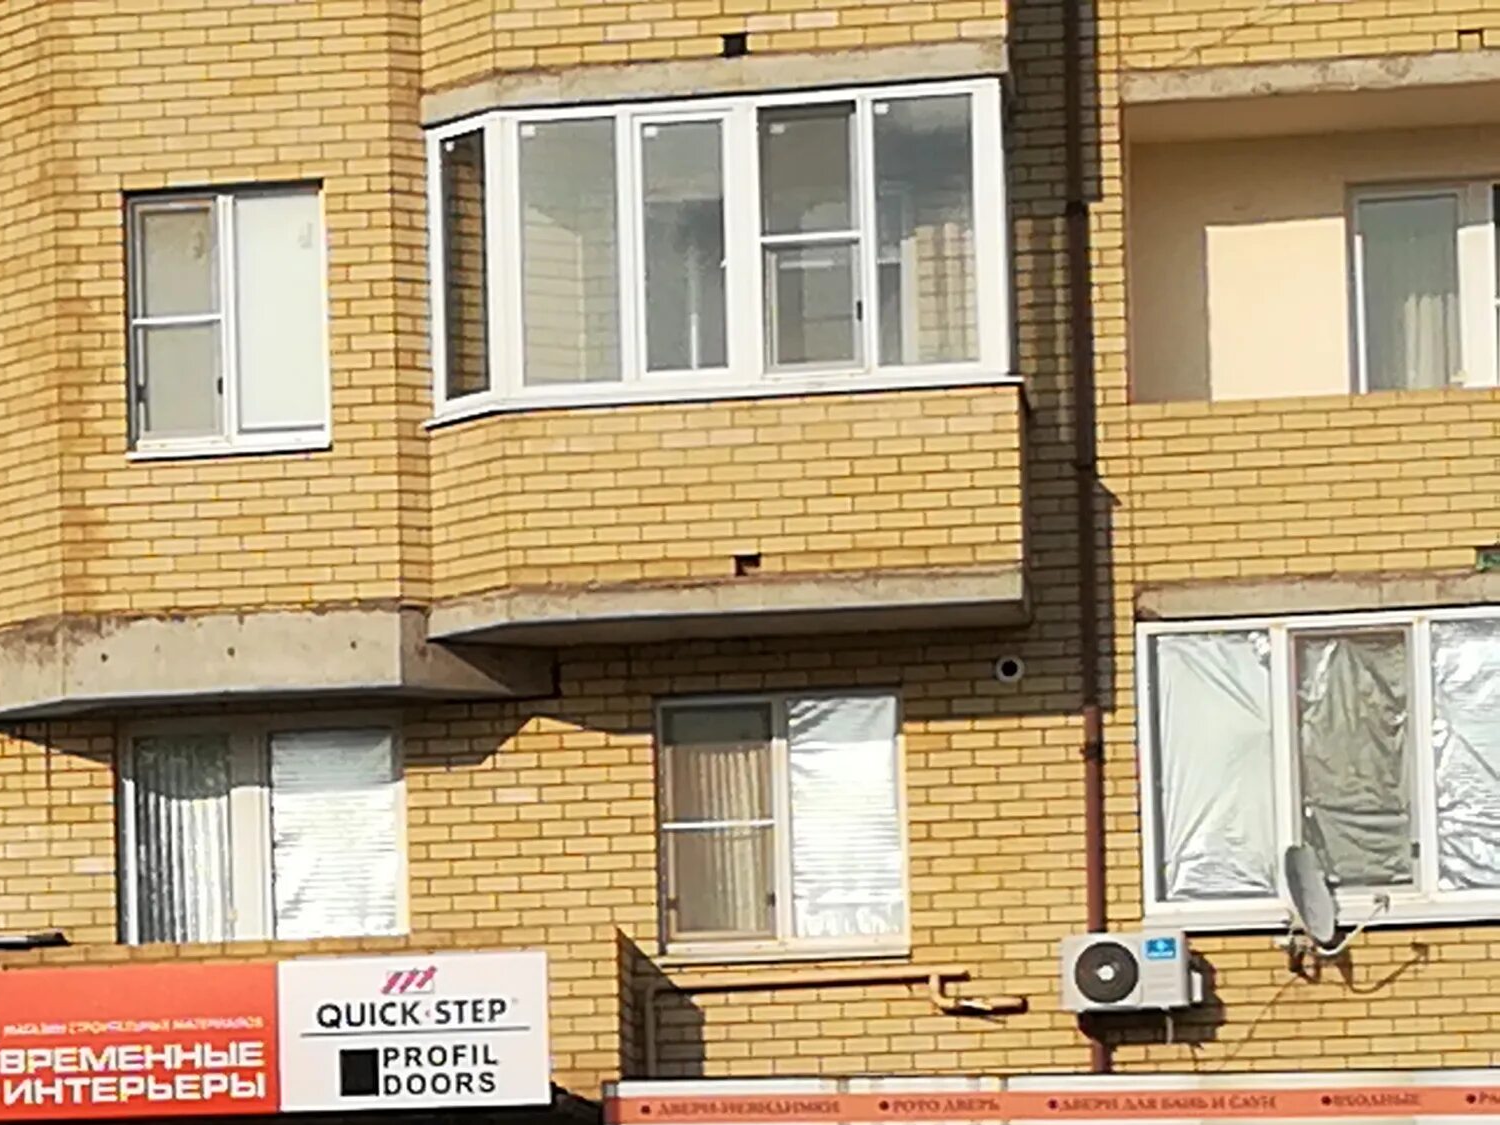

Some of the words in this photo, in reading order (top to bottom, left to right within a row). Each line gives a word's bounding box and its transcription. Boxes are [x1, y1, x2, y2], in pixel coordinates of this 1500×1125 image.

[383, 1044, 499, 1068] PROFIL
[3, 1072, 266, 1105] ИНТЕРЬЕРЫ
[383, 1072, 496, 1096] DOORS
